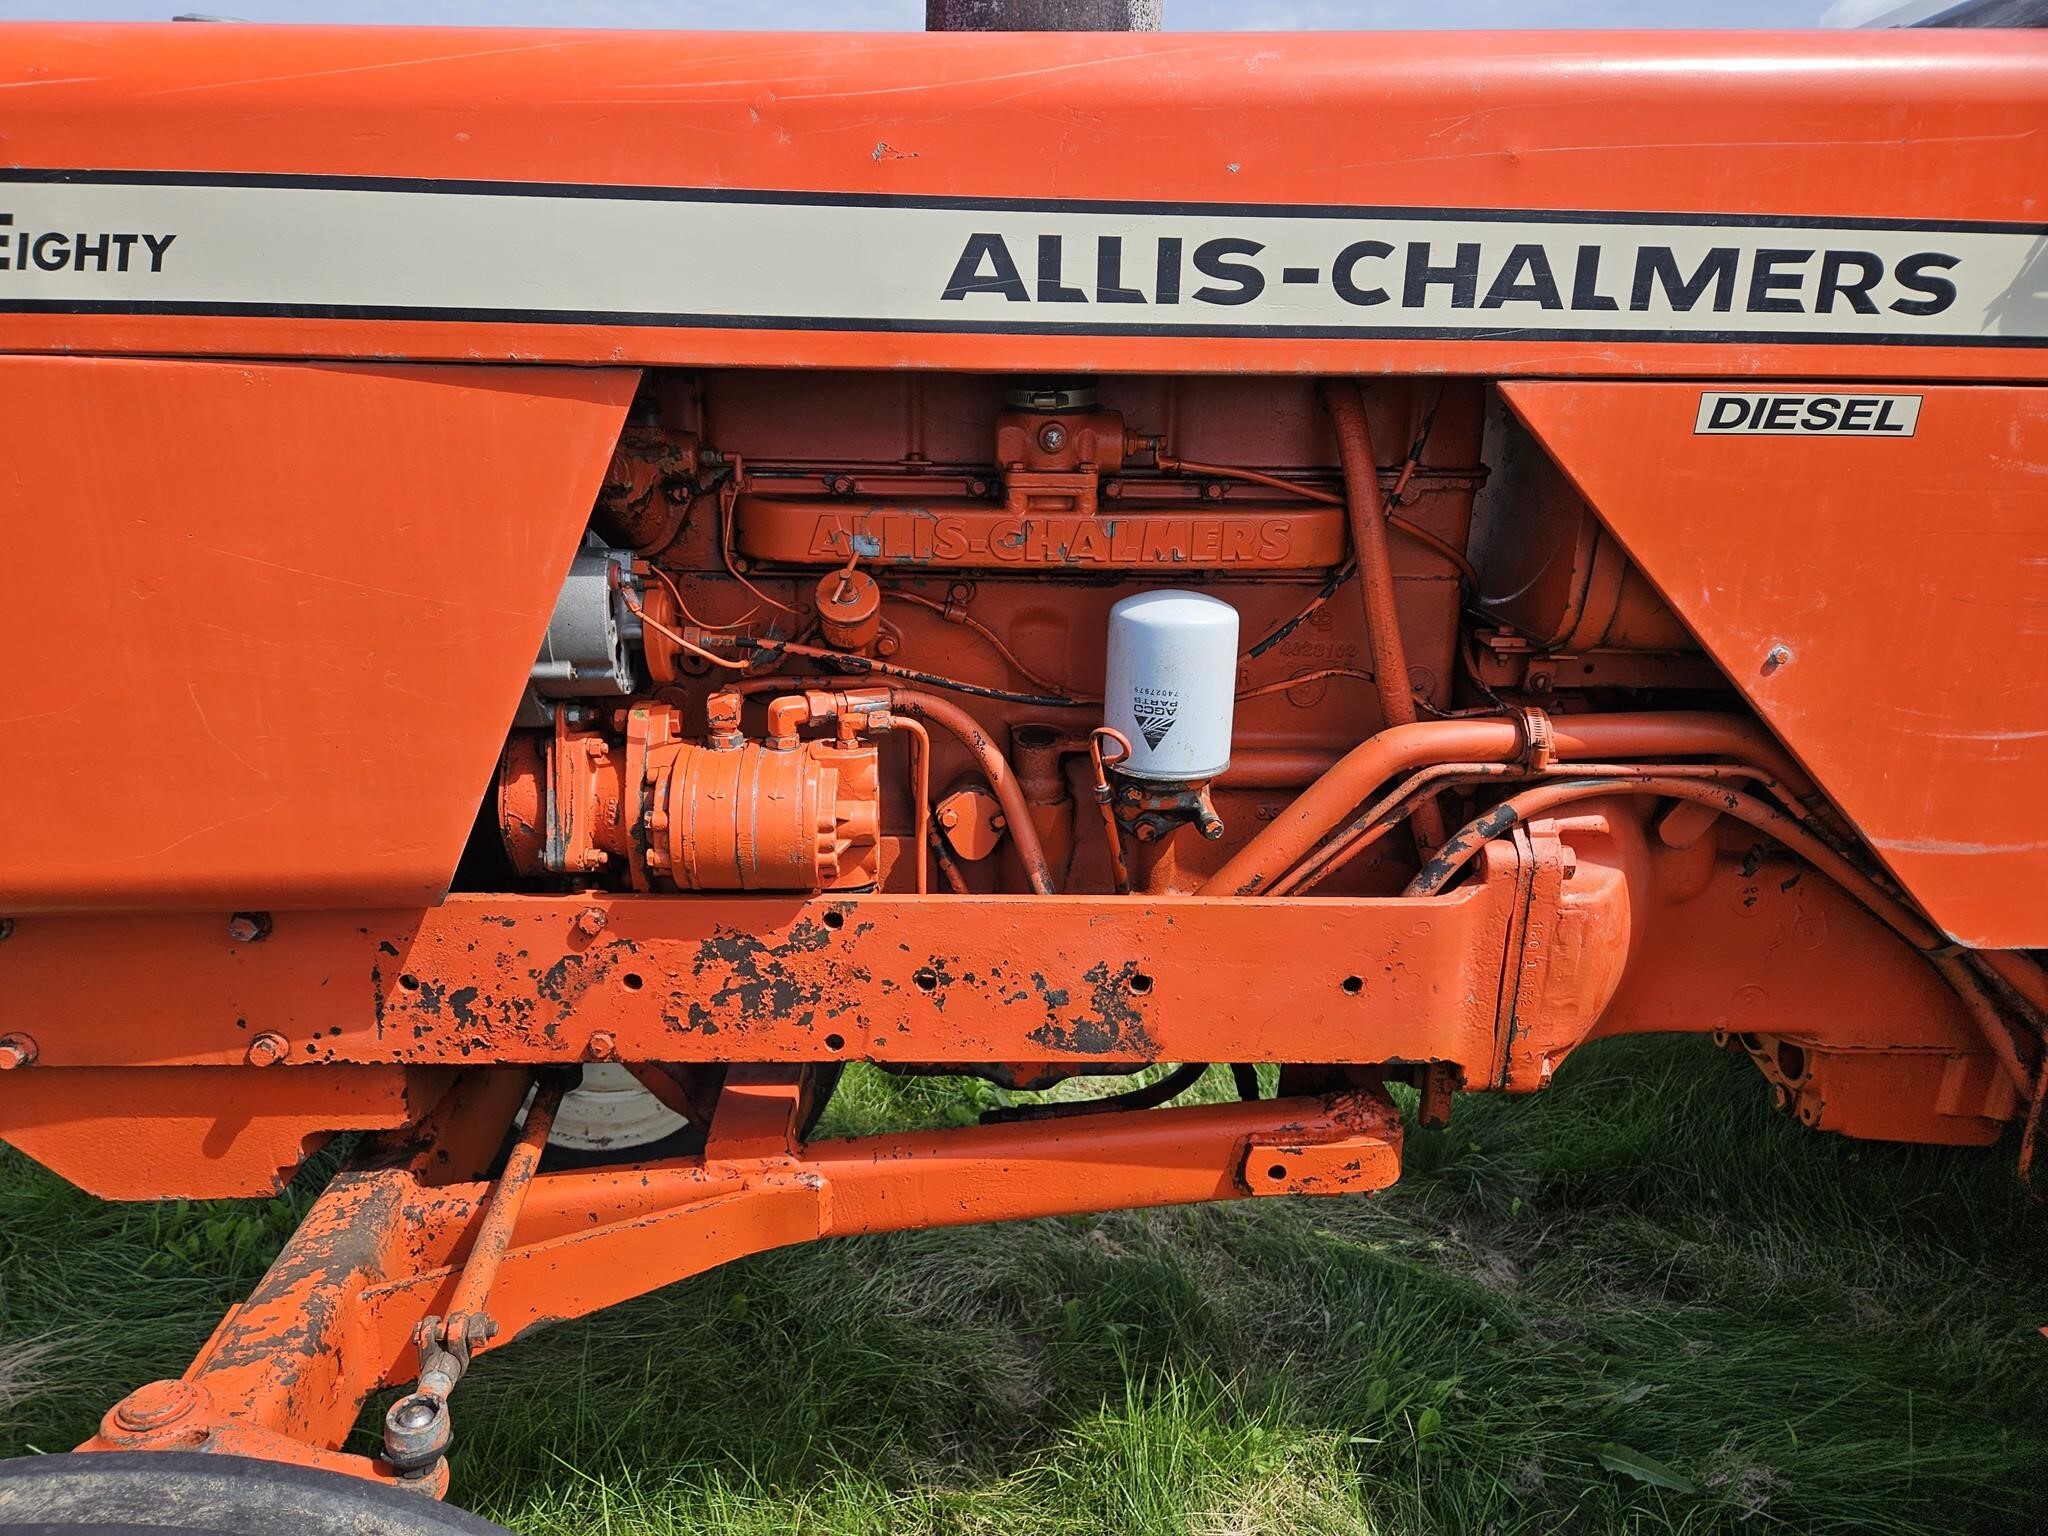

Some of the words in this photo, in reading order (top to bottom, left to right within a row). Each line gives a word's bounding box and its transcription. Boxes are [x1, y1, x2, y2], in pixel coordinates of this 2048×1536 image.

[941, 233, 1962, 316] ALLIS-CHALMERS
[1707, 397, 1904, 431] DIESEL
[808, 513, 1291, 563] ALLIS-CHALMERS
[1133, 696, 1178, 707] PARTS
[1134, 686, 1179, 697] 74027979
[1133, 704, 1177, 716] AGCO
